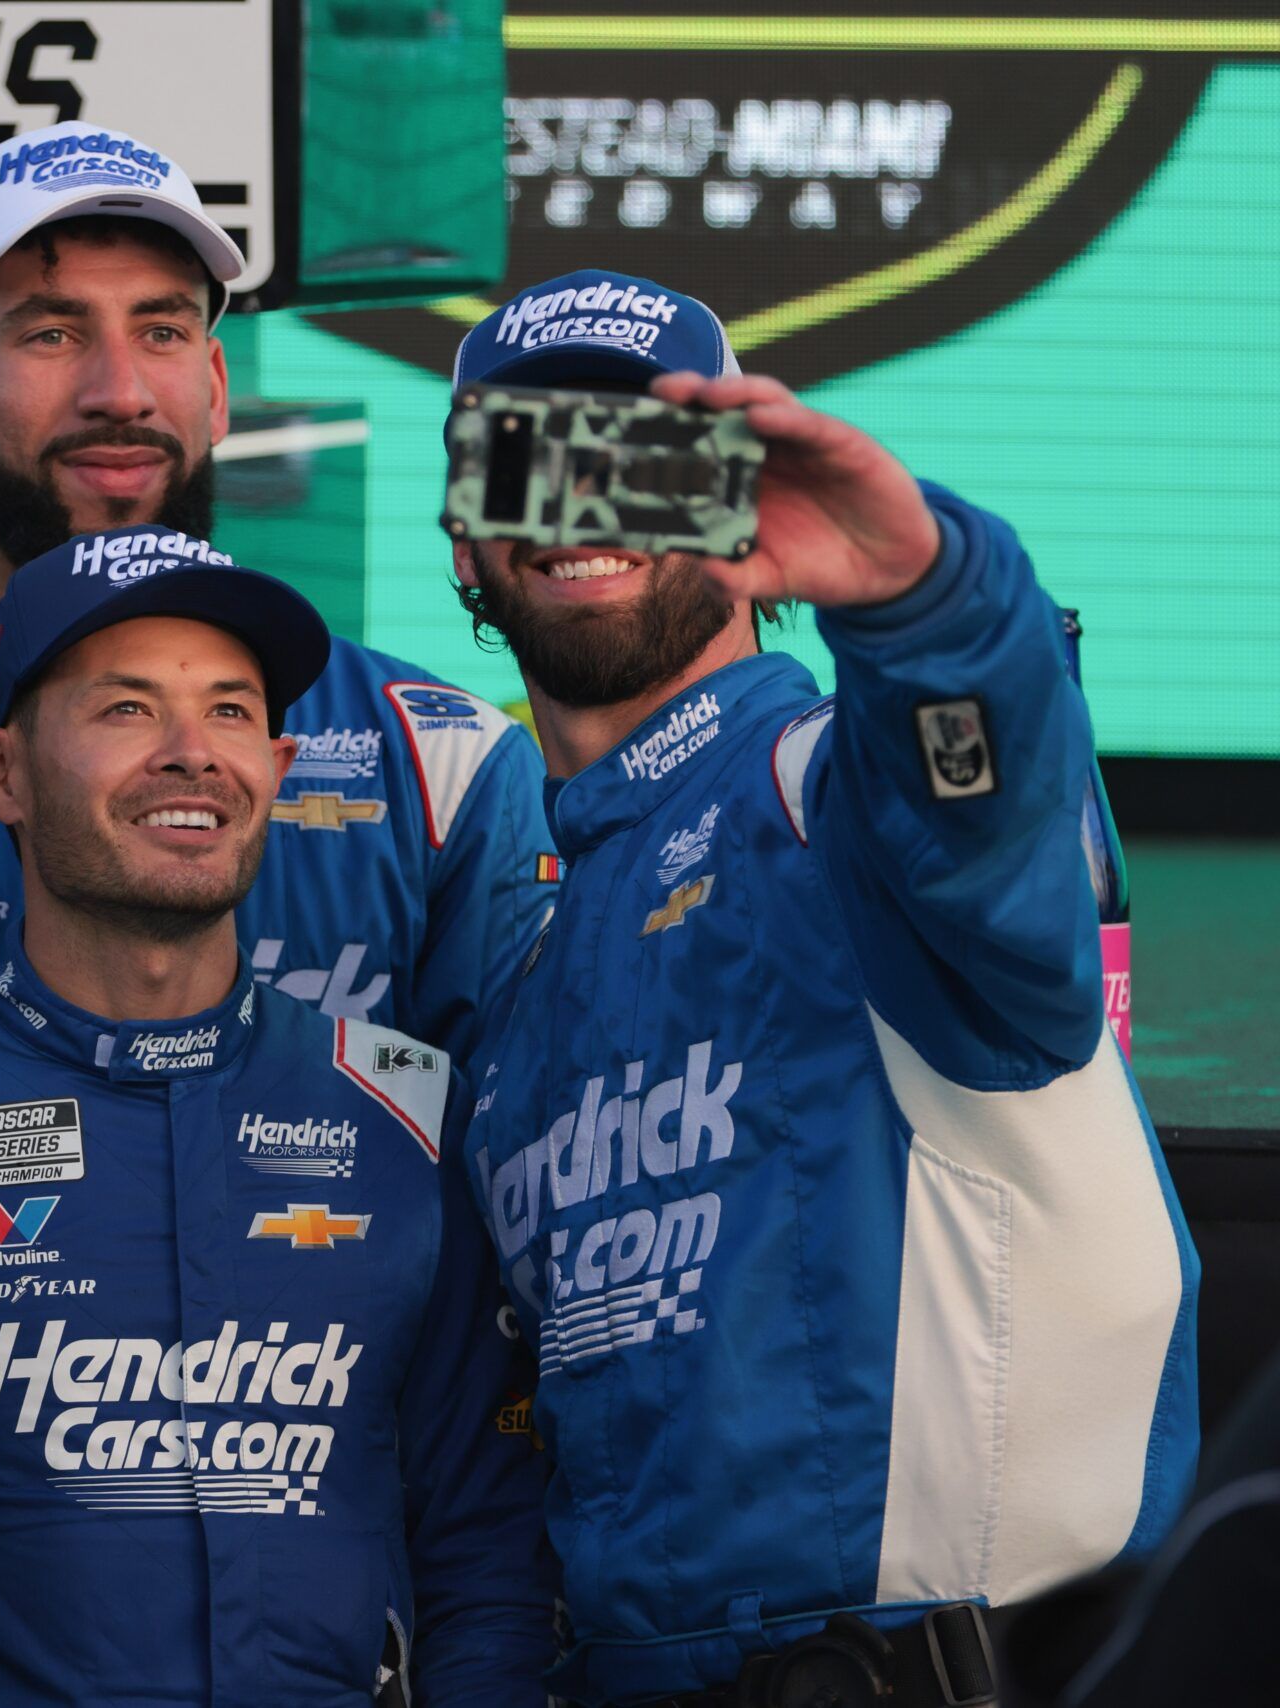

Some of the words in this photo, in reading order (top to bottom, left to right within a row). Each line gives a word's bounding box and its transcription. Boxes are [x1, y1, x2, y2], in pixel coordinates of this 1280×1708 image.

[32, 156, 160, 187] Cars.com
[496, 281, 678, 346] Hendrick
[522, 316, 660, 348] Cars.com
[280, 727, 383, 753] ndrick
[417, 719, 478, 731] SIMPSON
[620, 692, 721, 781] Hendrick
[648, 720, 721, 781] Cars.com
[128, 1025, 220, 1060] Hendrick
[142, 1052, 214, 1071] Cars.com
[237, 1113, 359, 1153] Hendrick
[475, 1040, 743, 1258] endrick
[259, 1146, 356, 1158] MOTORSPORTS
[44, 1407, 335, 1472] Cars.com
